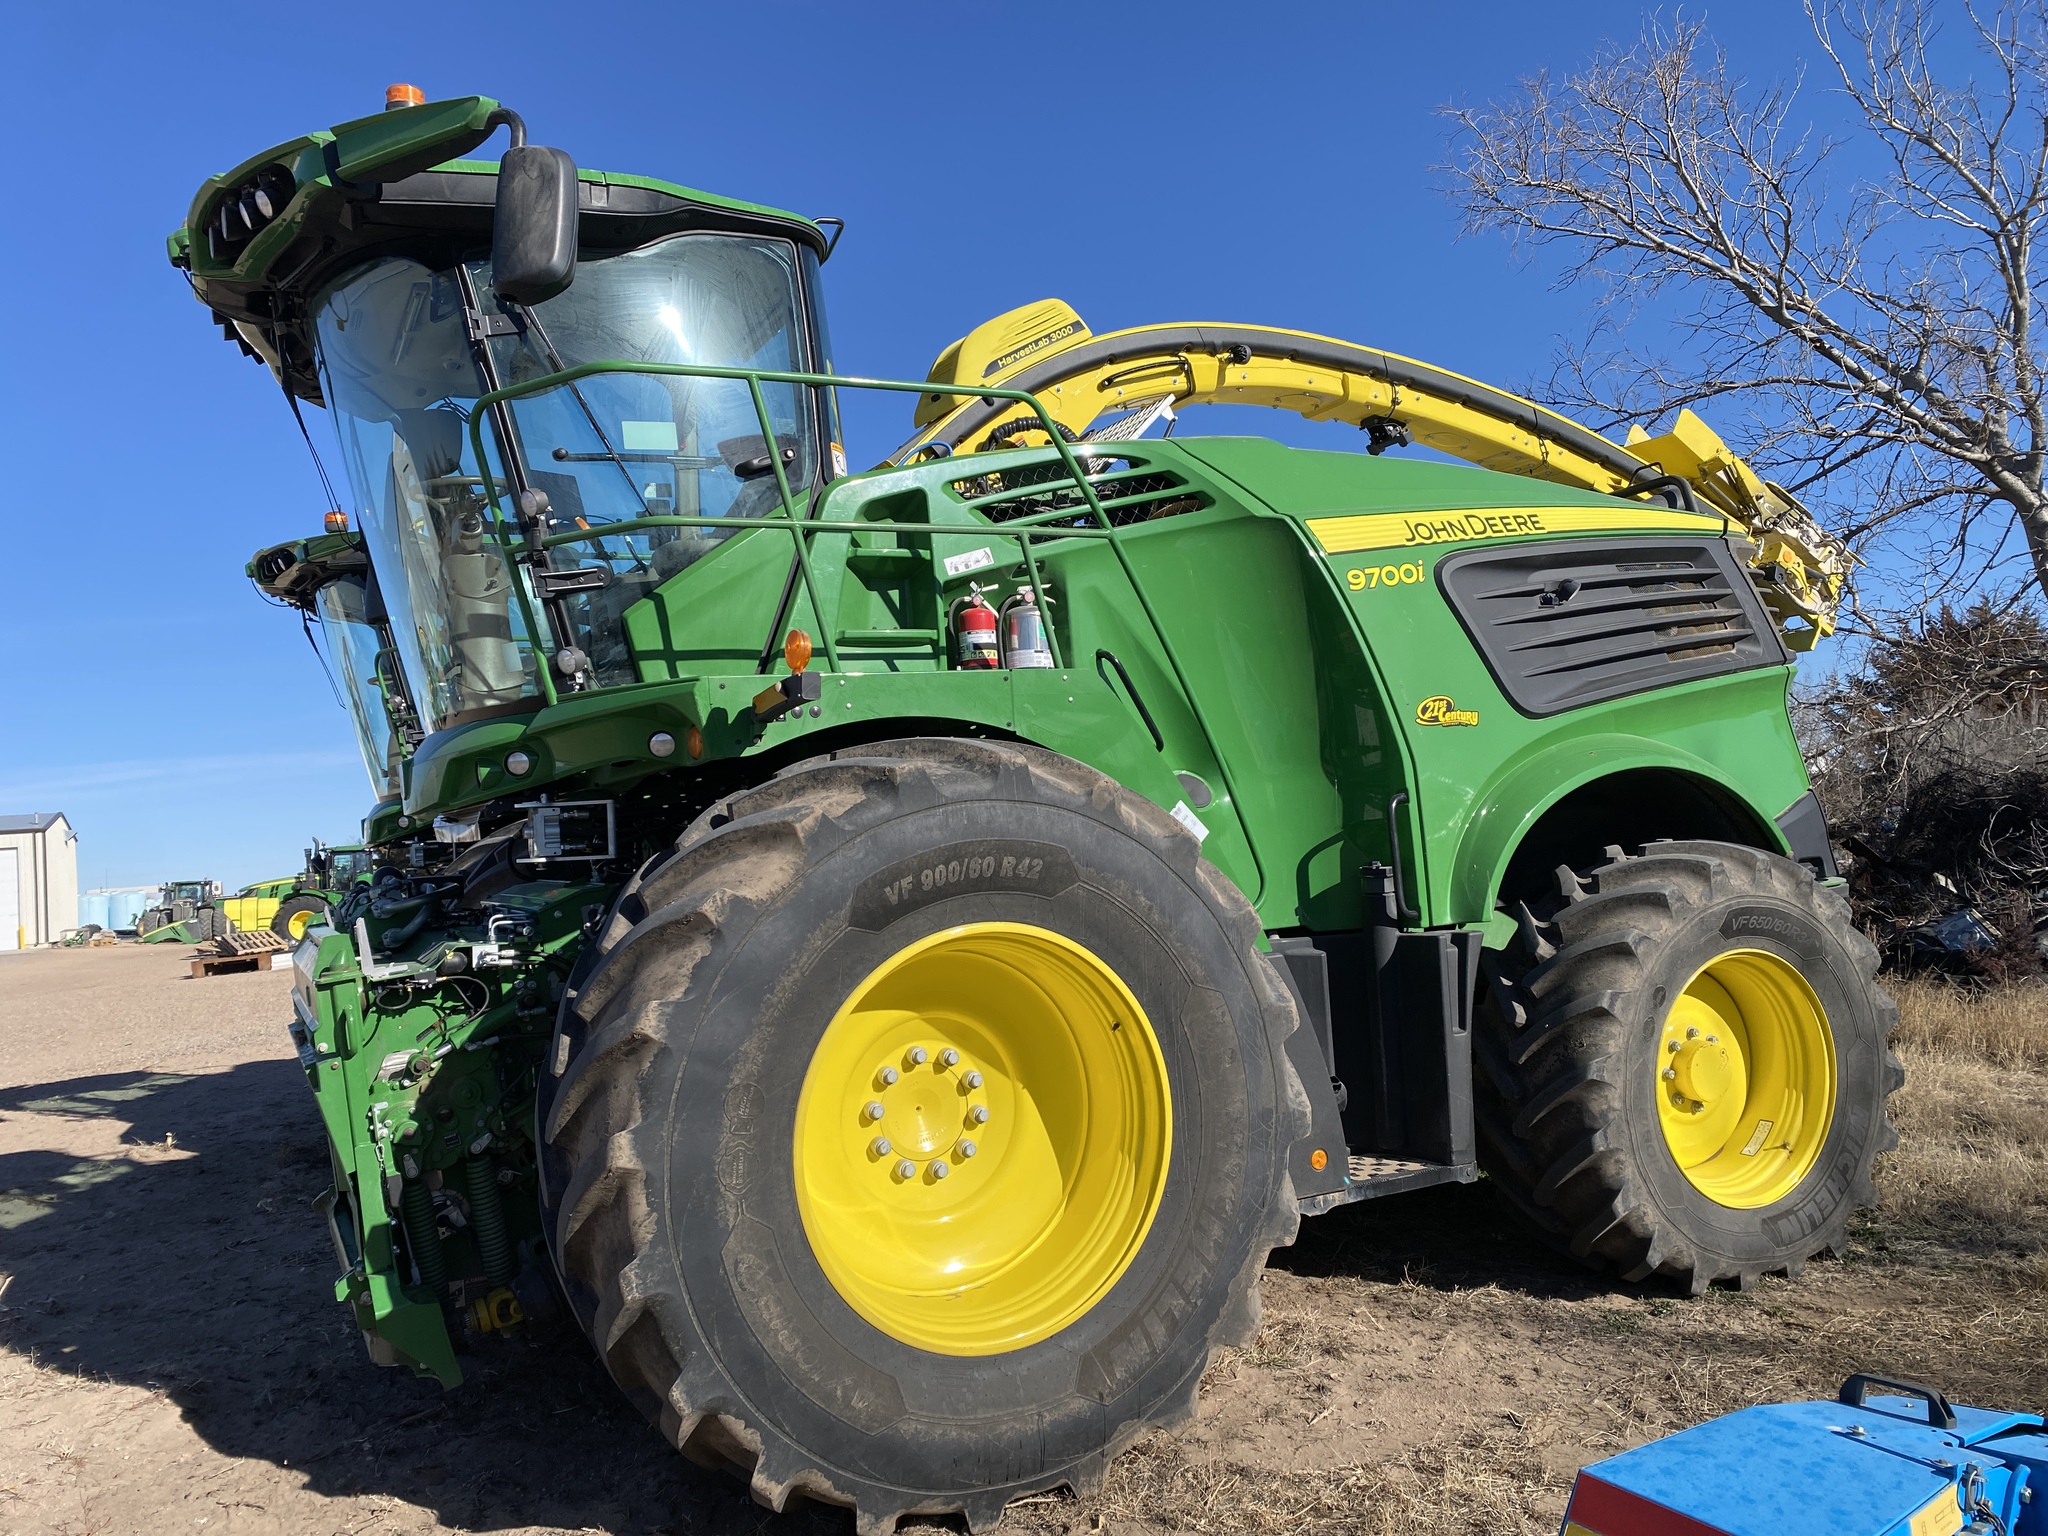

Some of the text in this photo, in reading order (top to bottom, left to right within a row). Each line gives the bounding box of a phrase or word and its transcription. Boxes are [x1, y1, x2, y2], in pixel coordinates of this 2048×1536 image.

[997, 325, 1074, 368] HarvestLab 3000
[1404, 514, 1546, 543] JOHN DEERE
[1346, 559, 1426, 591] 9700i
[883, 856, 1044, 906] VF 900/60 R42
[1777, 1103, 1870, 1246] MICHELIN
